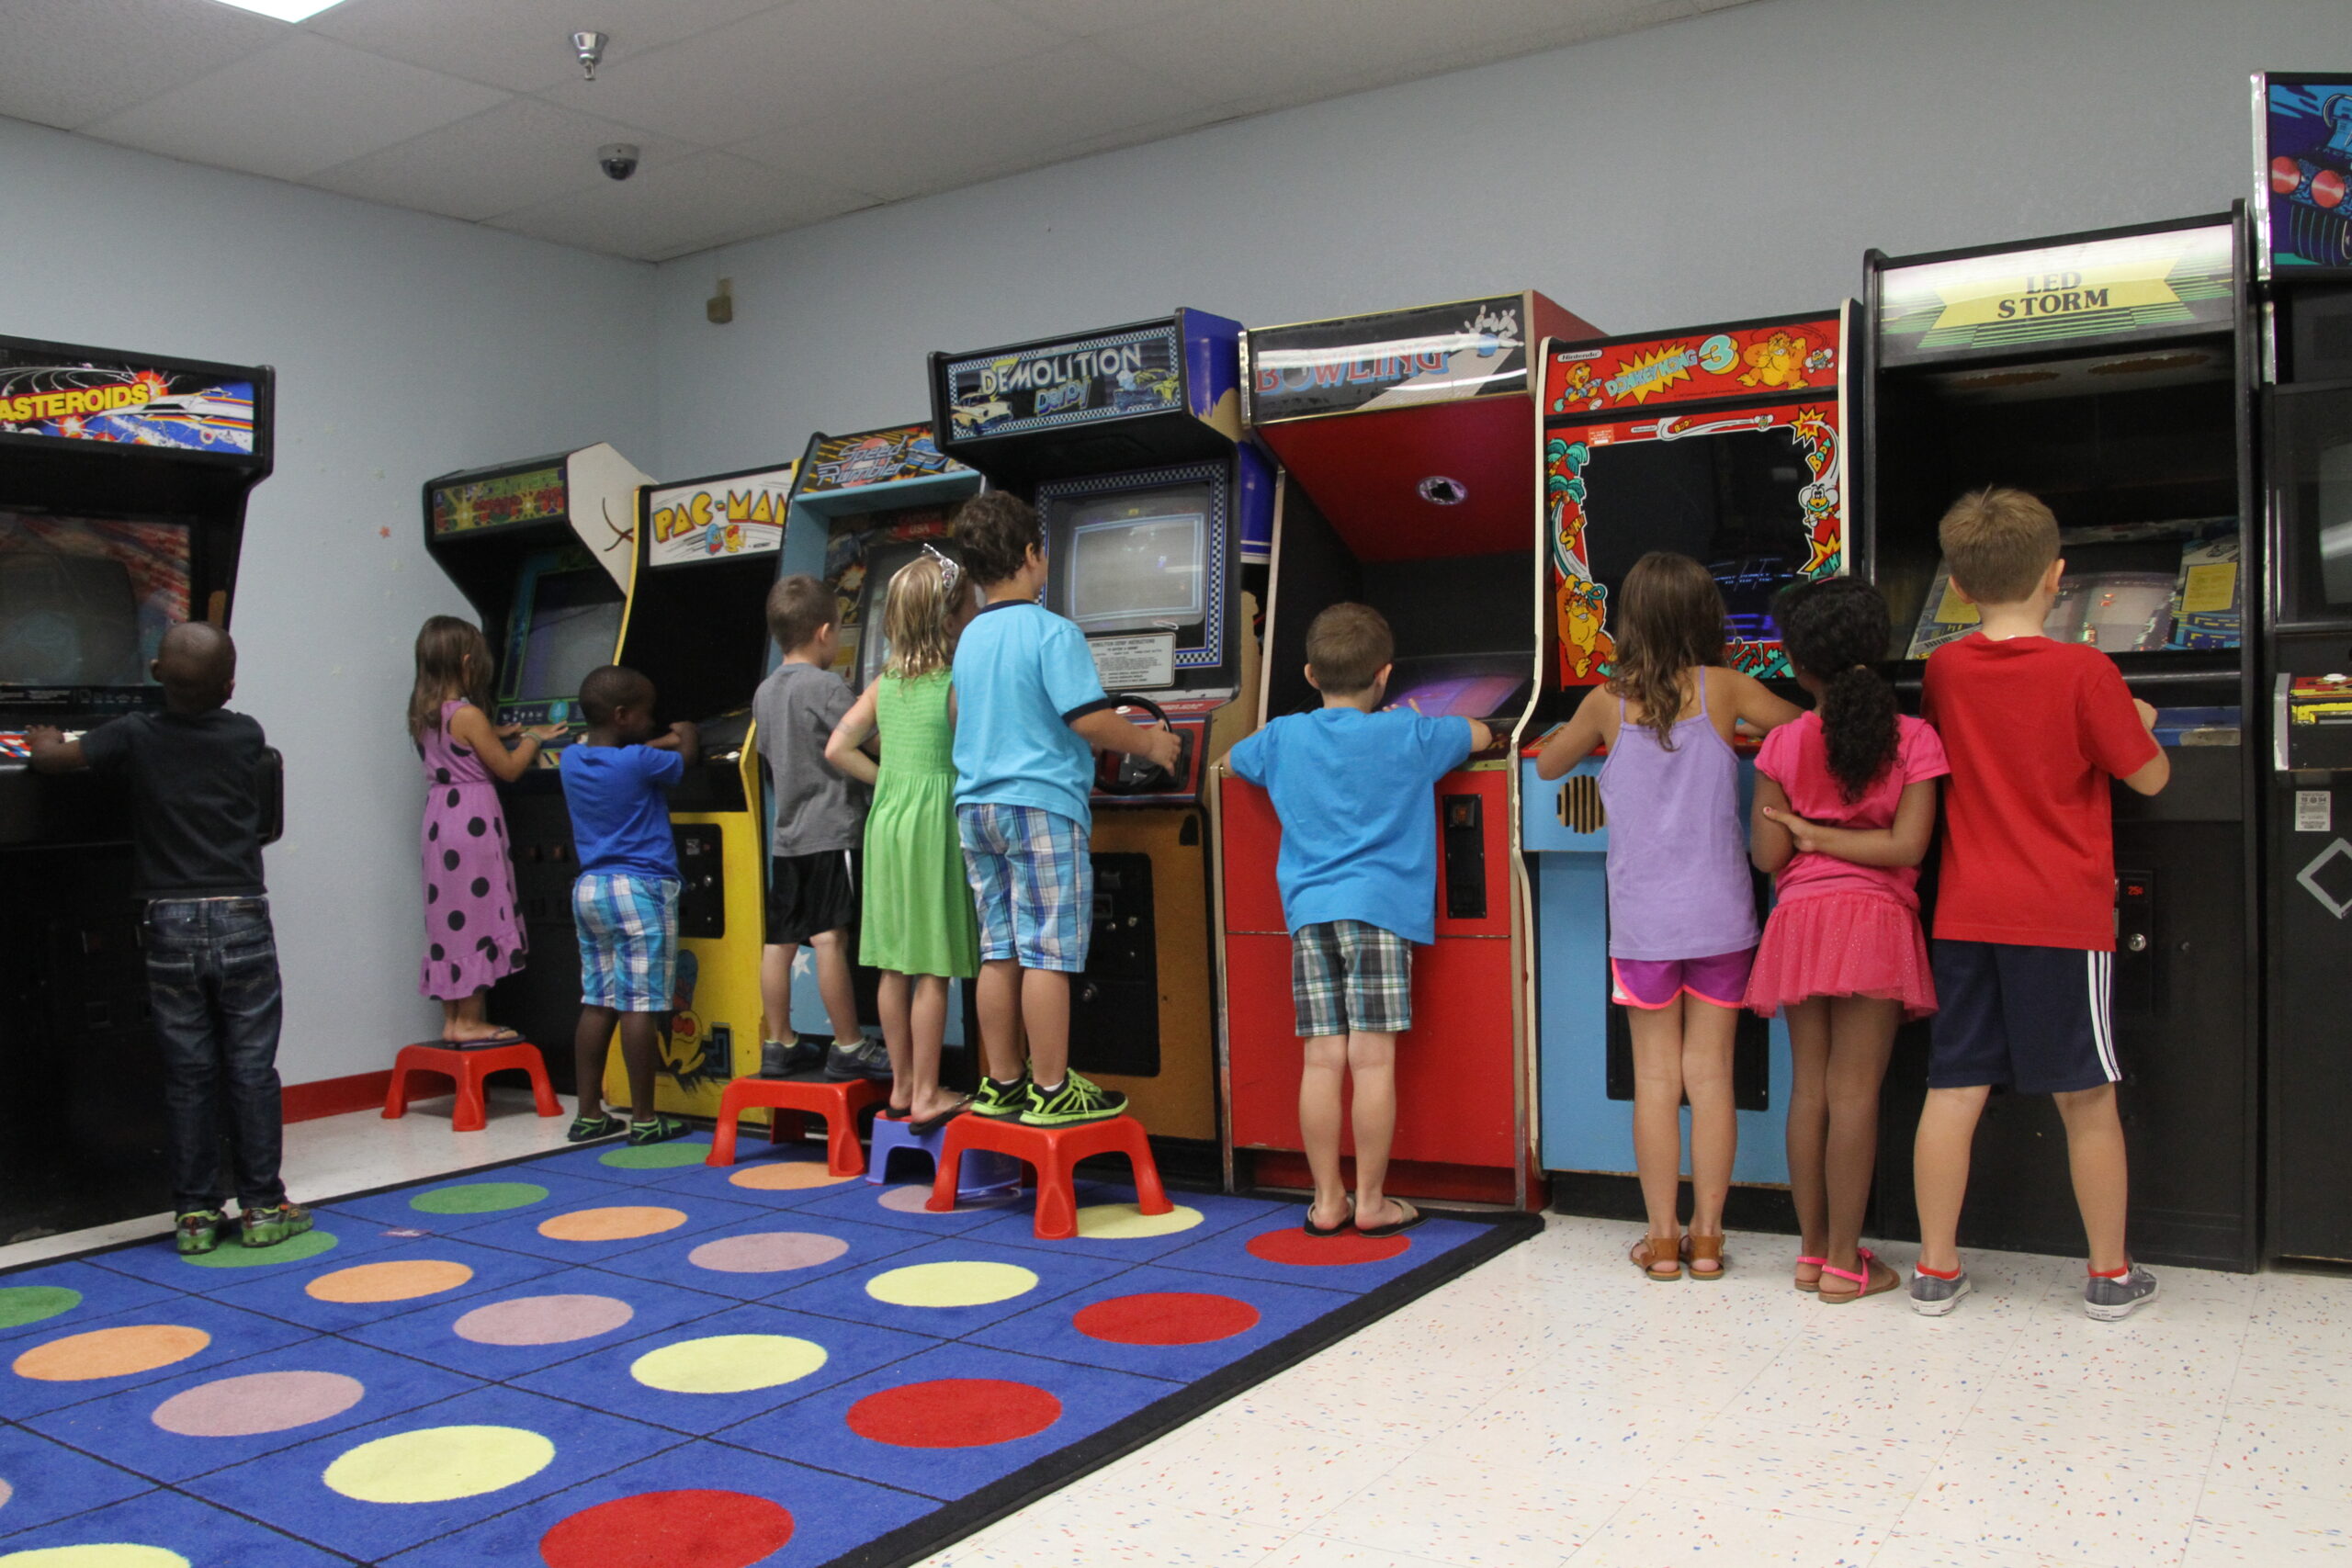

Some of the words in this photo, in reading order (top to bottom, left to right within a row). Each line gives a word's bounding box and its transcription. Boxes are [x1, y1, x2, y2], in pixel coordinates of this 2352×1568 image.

[2026, 271, 2082, 295] LED
[1997, 288, 2109, 320] STORM
[979, 343, 1142, 394] DEMOLITION
[1253, 342, 1448, 396] BOWLING
[1562, 351, 1599, 361] Nintendo
[1604, 364, 1659, 397] DONKEY
[1657, 349, 1699, 378] KONG
[1699, 334, 1739, 375] 3
[0, 383, 150, 423] ASTEROIDS
[838, 434, 908, 469] Speed
[817, 461, 906, 486] Rumbler
[652, 490, 786, 544] PAC-MAN
